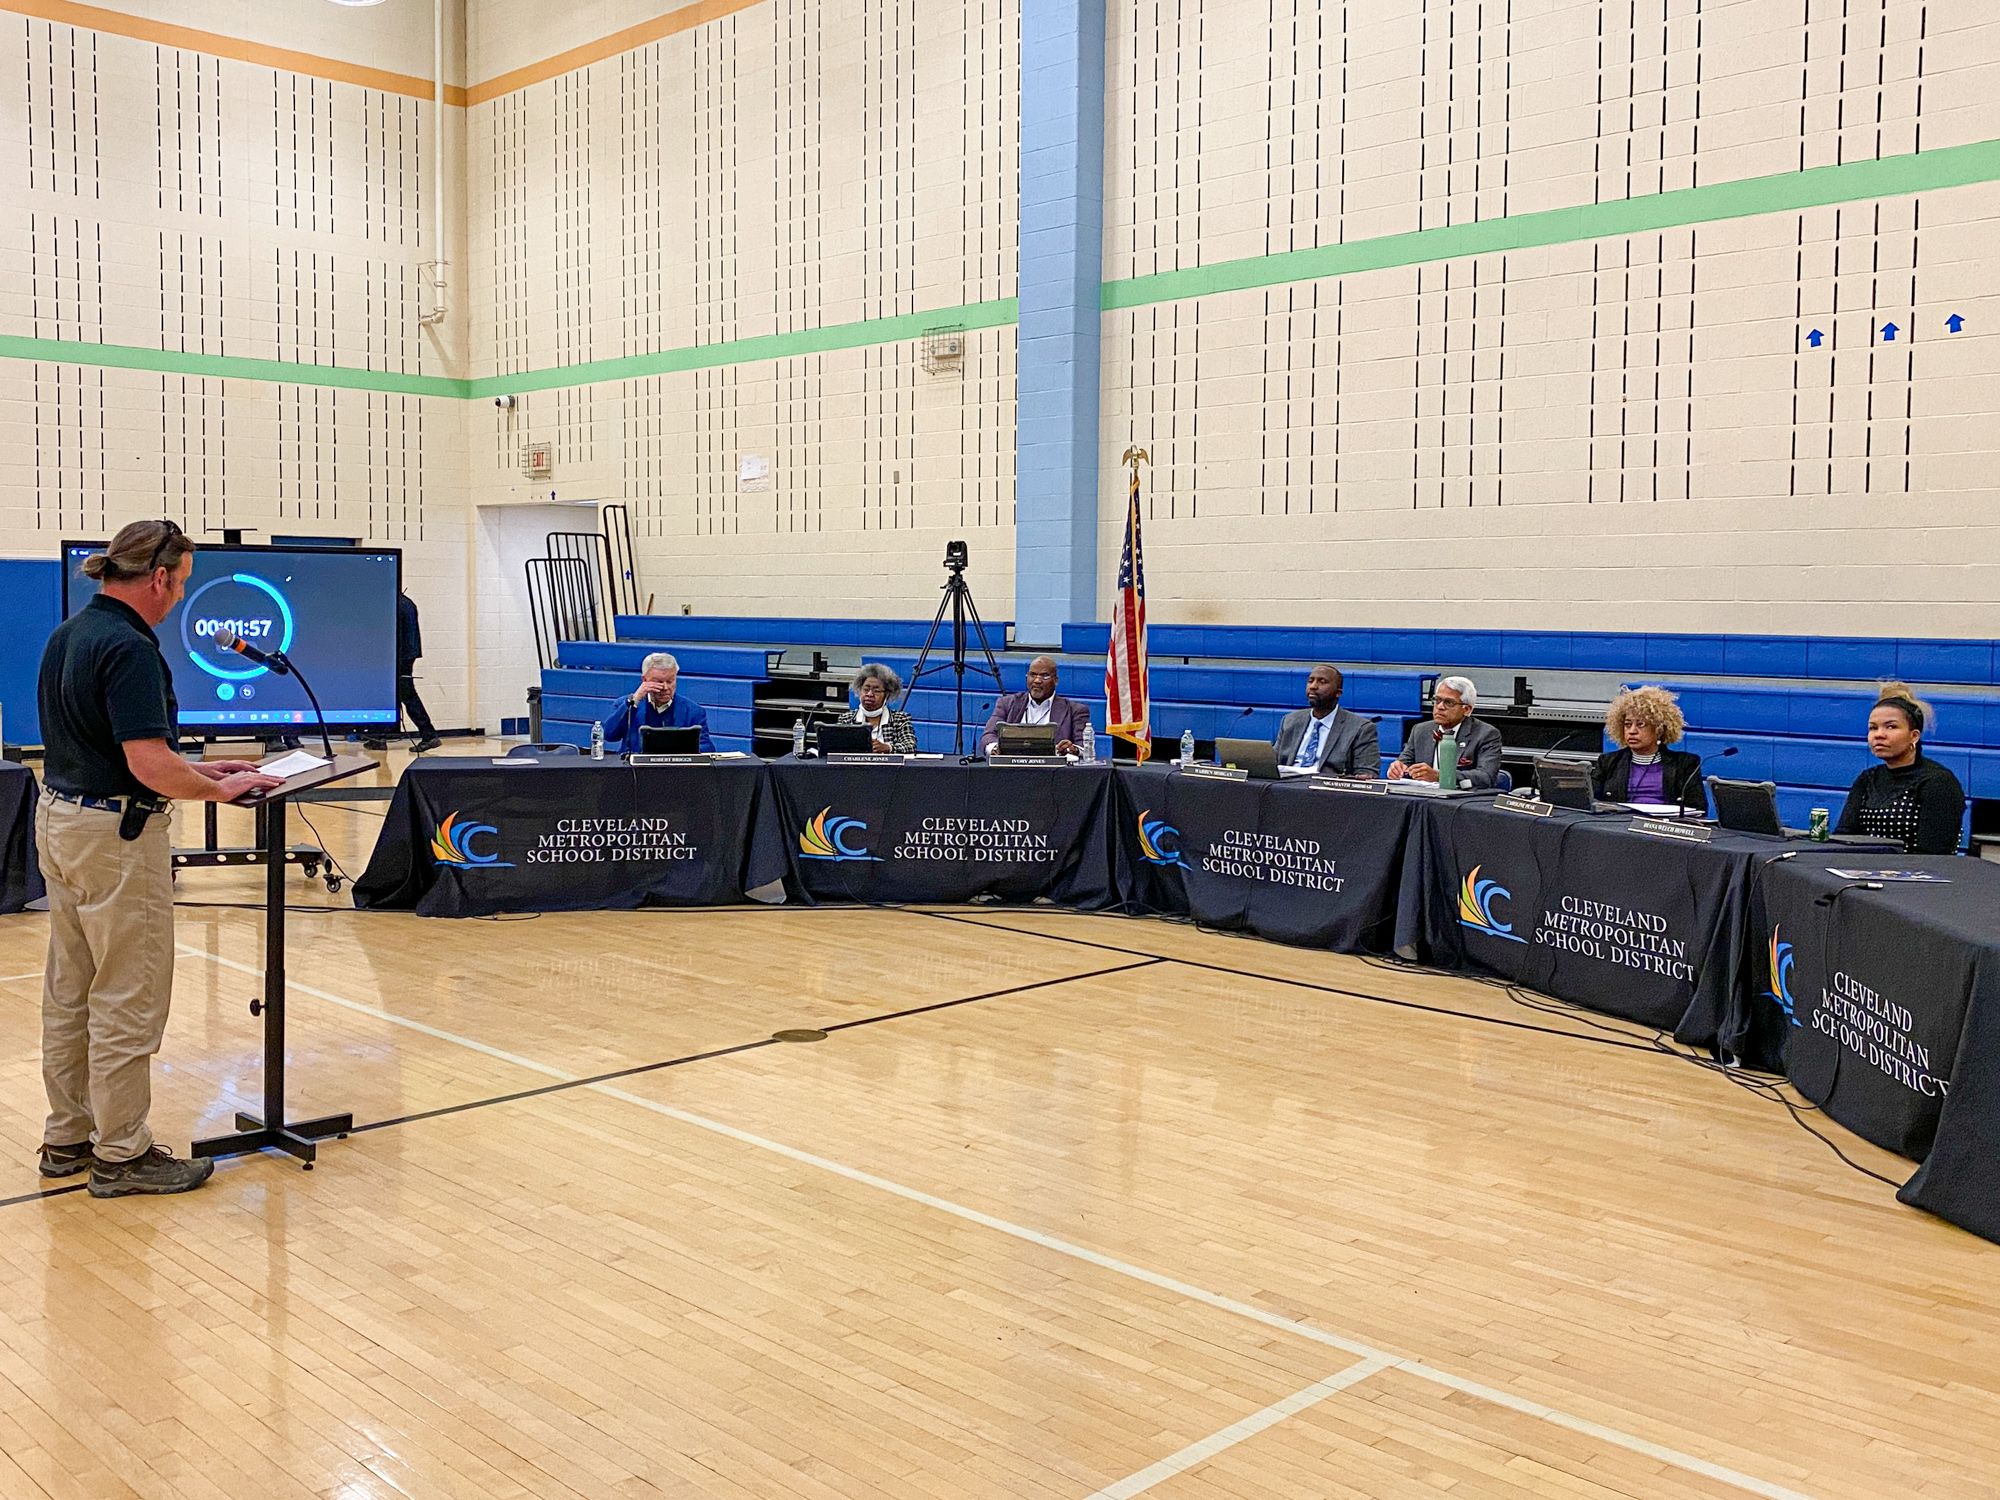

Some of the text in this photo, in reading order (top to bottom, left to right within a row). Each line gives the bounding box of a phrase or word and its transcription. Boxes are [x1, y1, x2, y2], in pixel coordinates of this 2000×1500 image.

[195, 619, 272, 637] 00:01:57
[557, 818, 669, 834] CLEVELAND
[922, 817, 1030, 833] CLEVELAND
[538, 832, 687, 848] METROPOLITAN
[904, 832, 1047, 848] METROPOLITAN
[1223, 829, 1320, 856] CLEVELAND
[526, 846, 697, 863] SCHOOL DISTRICT
[894, 846, 1058, 863] SCHOOL DISTRICT
[1209, 844, 1336, 874] METROPOLITAN
[1202, 857, 1345, 893] SCHOOL DISTRICT
[1561, 895, 1667, 933] CLEVELAND
[1544, 910, 1685, 959] METROPOLITAN
[1535, 927, 1695, 983] SCHOOL DISTRICT
[1834, 971, 1913, 1033] CLEVELAND
[1822, 988, 1930, 1071] METROPOLITAN
[1812, 1009, 1951, 1099] SCHOOL DISTRICT
